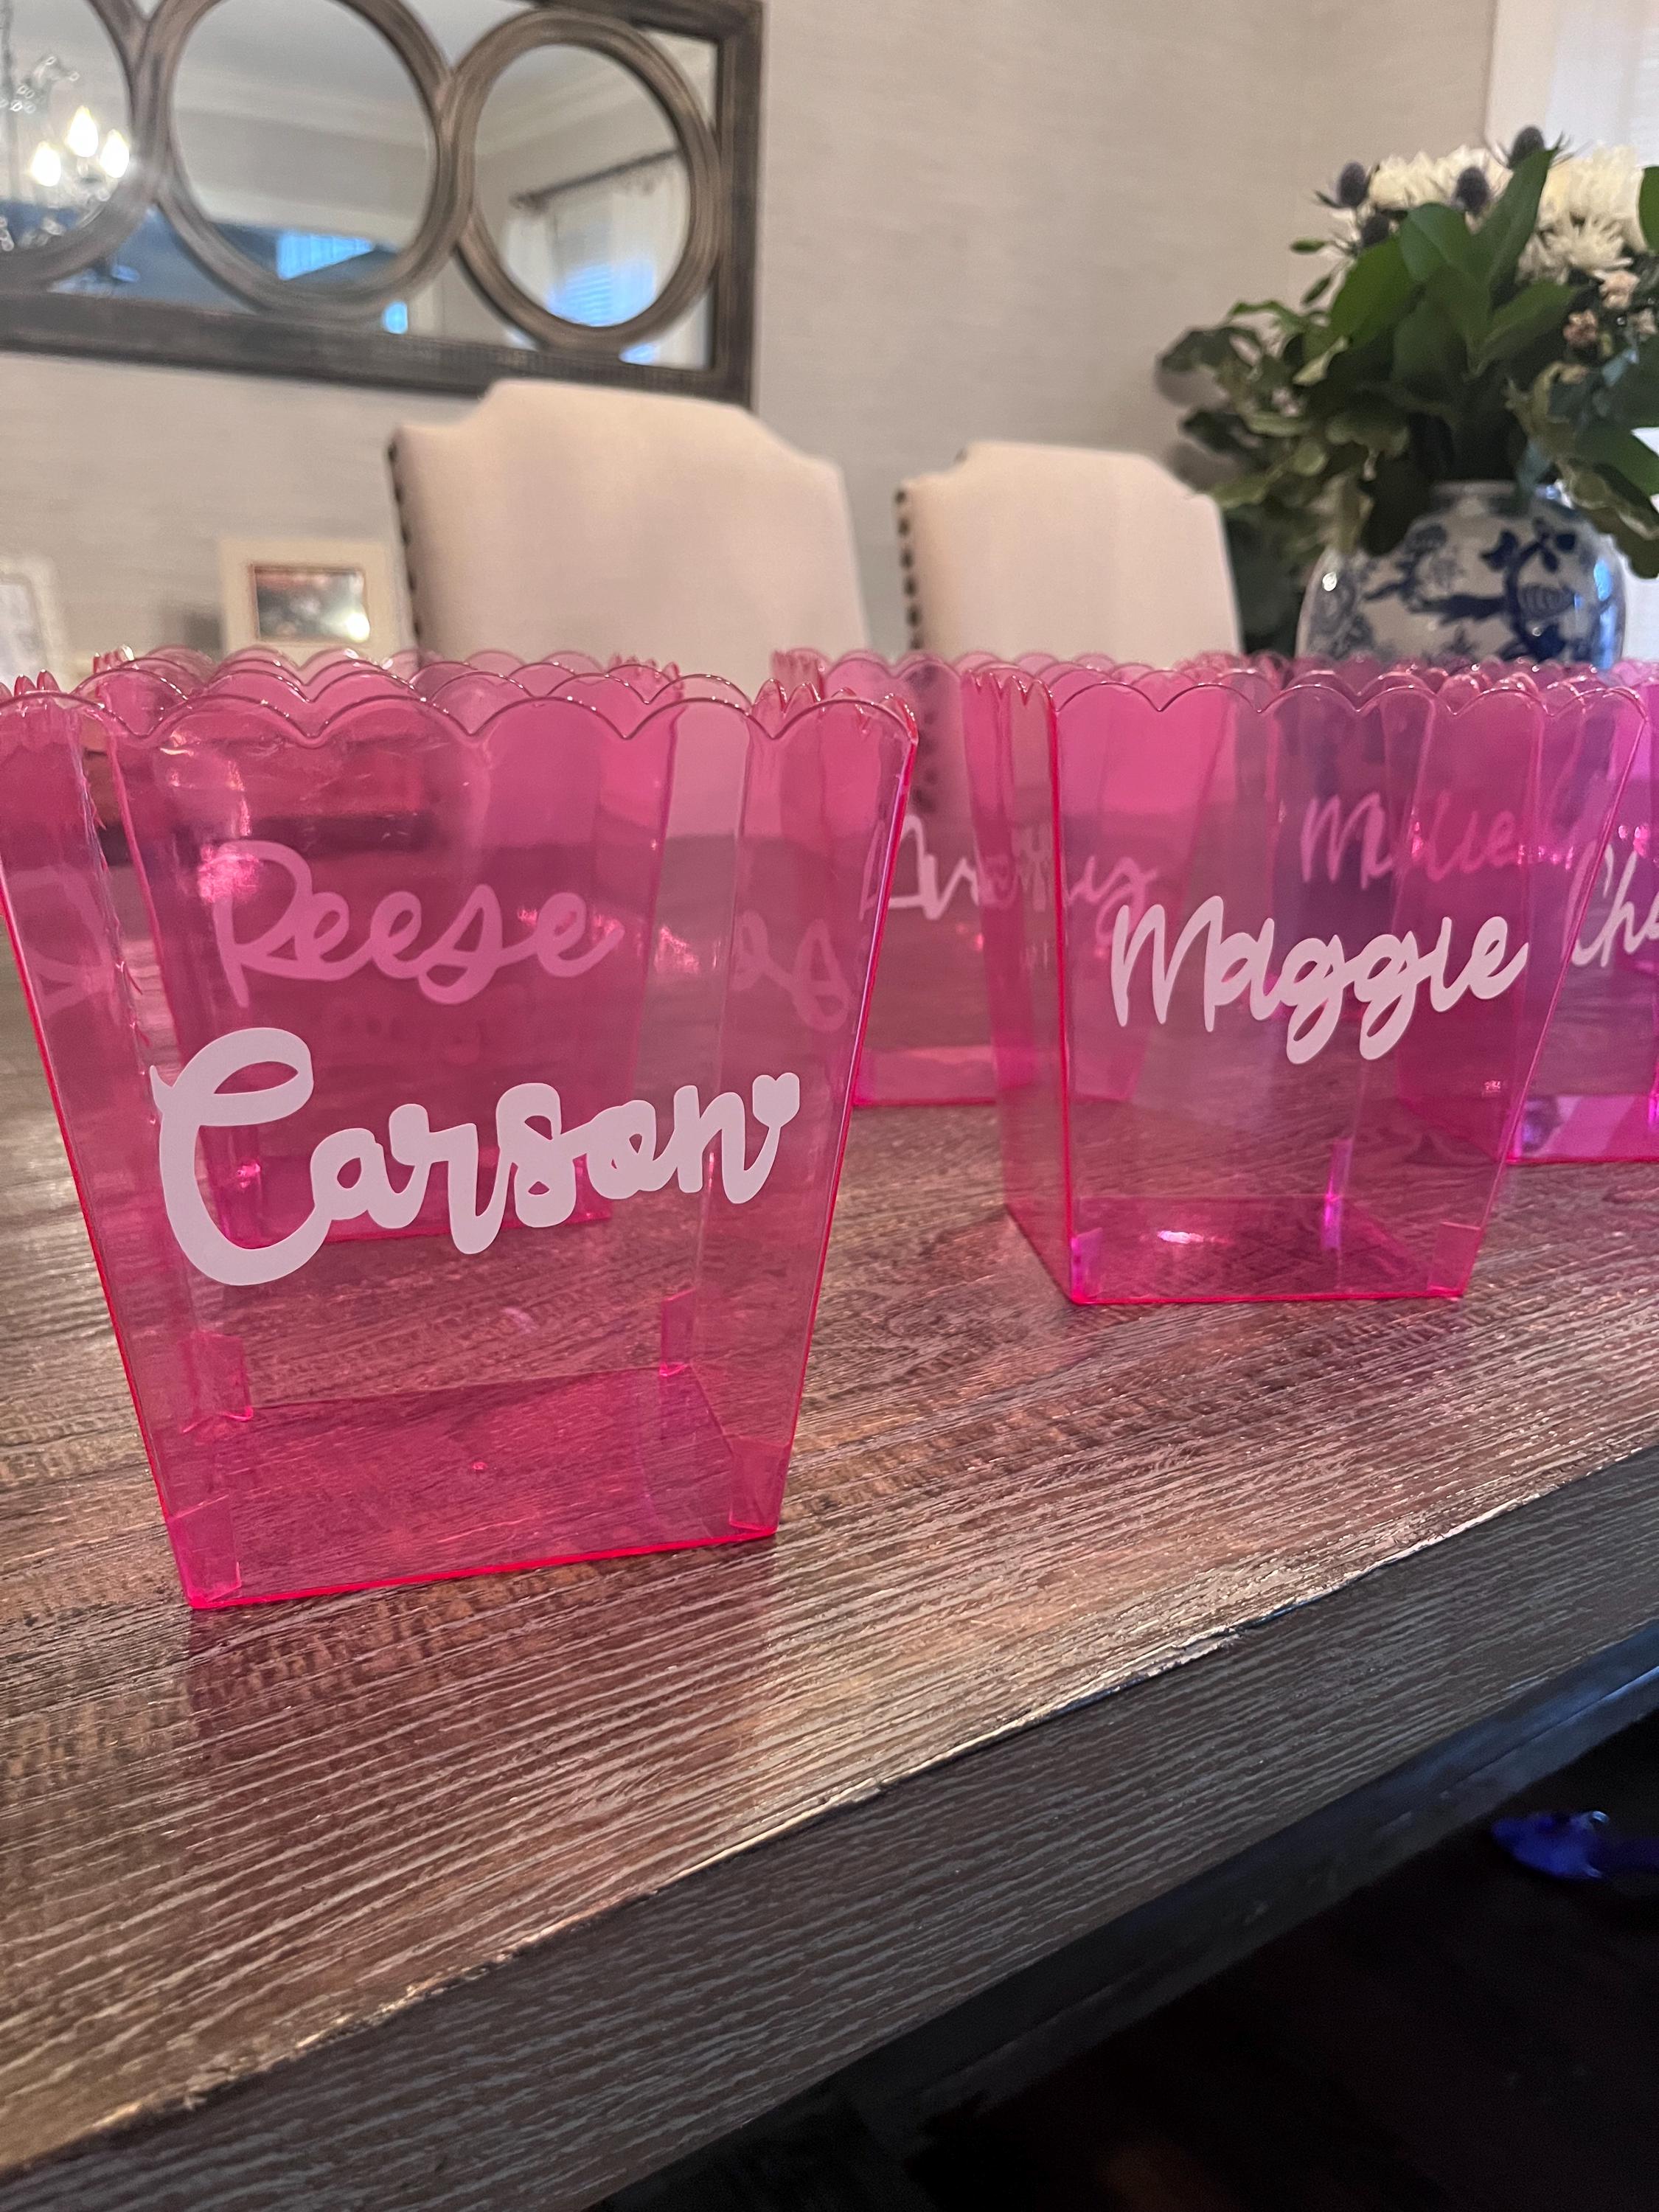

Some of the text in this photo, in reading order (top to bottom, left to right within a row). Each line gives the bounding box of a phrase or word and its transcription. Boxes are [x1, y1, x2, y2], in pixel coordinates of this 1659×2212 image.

[211, 839, 625, 1008] Reese
[1110, 895, 1528, 1065] Maggie
[149, 1027, 801, 1286] Carson
